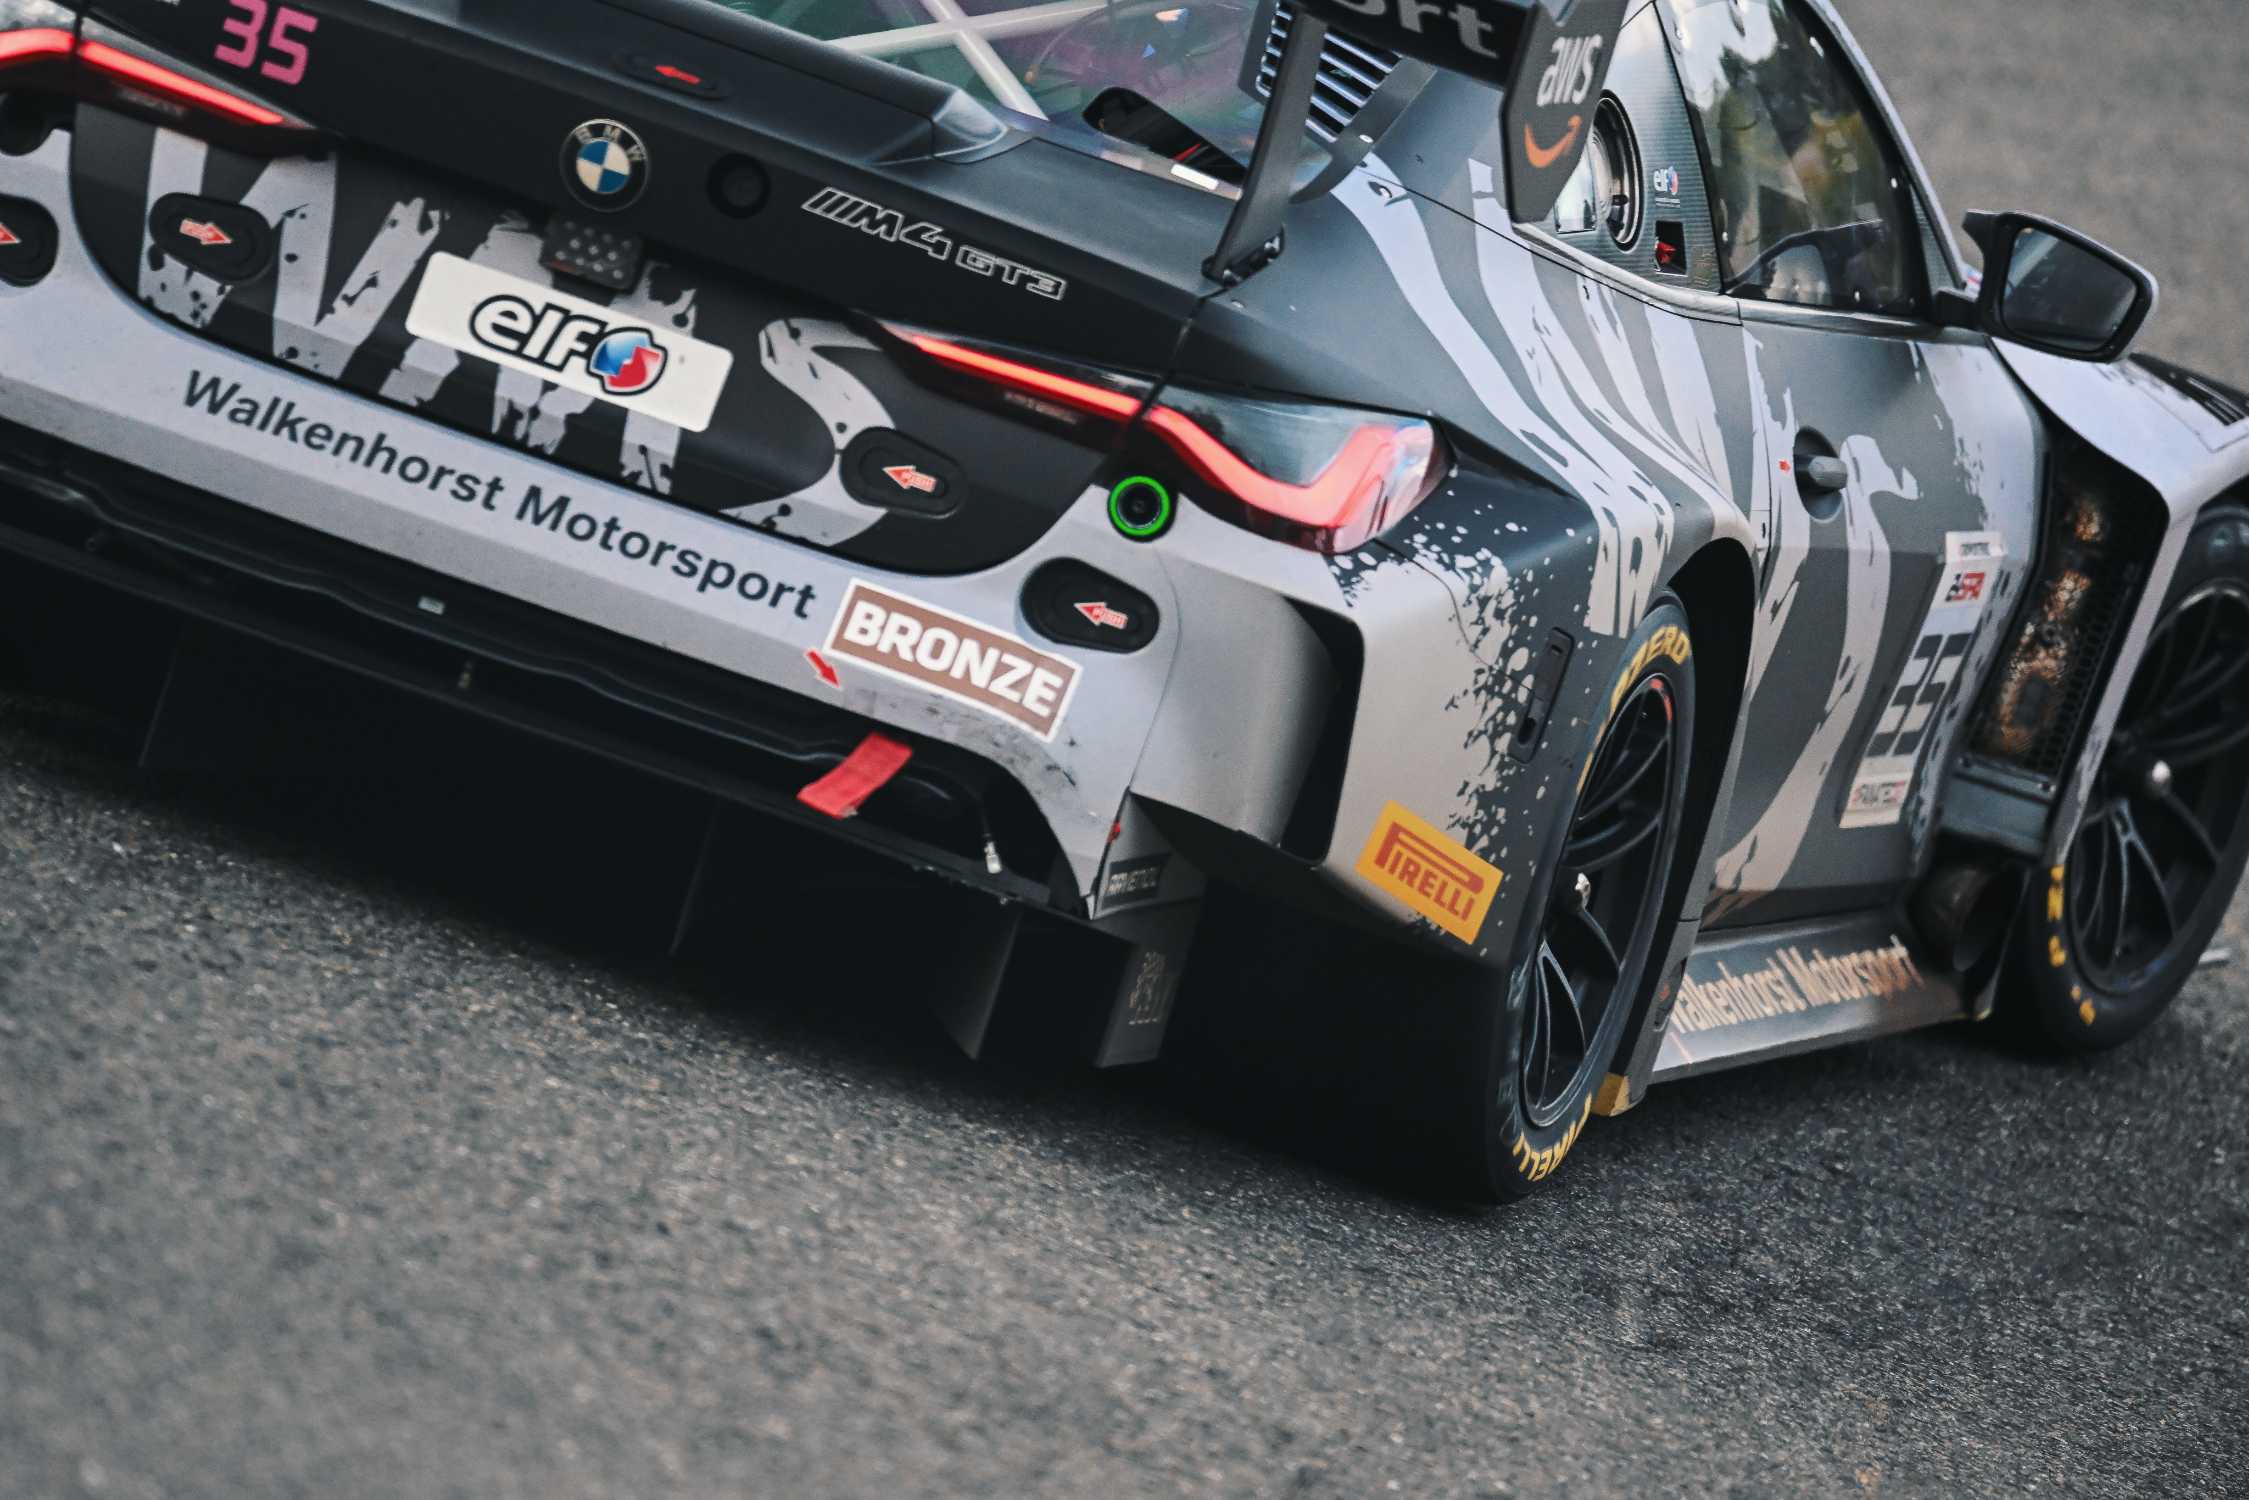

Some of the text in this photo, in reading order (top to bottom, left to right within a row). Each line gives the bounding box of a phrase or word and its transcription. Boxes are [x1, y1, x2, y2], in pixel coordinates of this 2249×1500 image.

[214, 0, 319, 85] 35
[1537, 34, 1603, 107] aws
[575, 125, 647, 163] BMW
[955, 245, 1067, 301] GT3
[468, 294, 608, 375] elf
[184, 369, 817, 619] Walkenhorst Motorsport
[842, 600, 1065, 718] BRONZE
[1866, 632, 1974, 757] 35
[1374, 821, 1485, 922] PIRELLI
